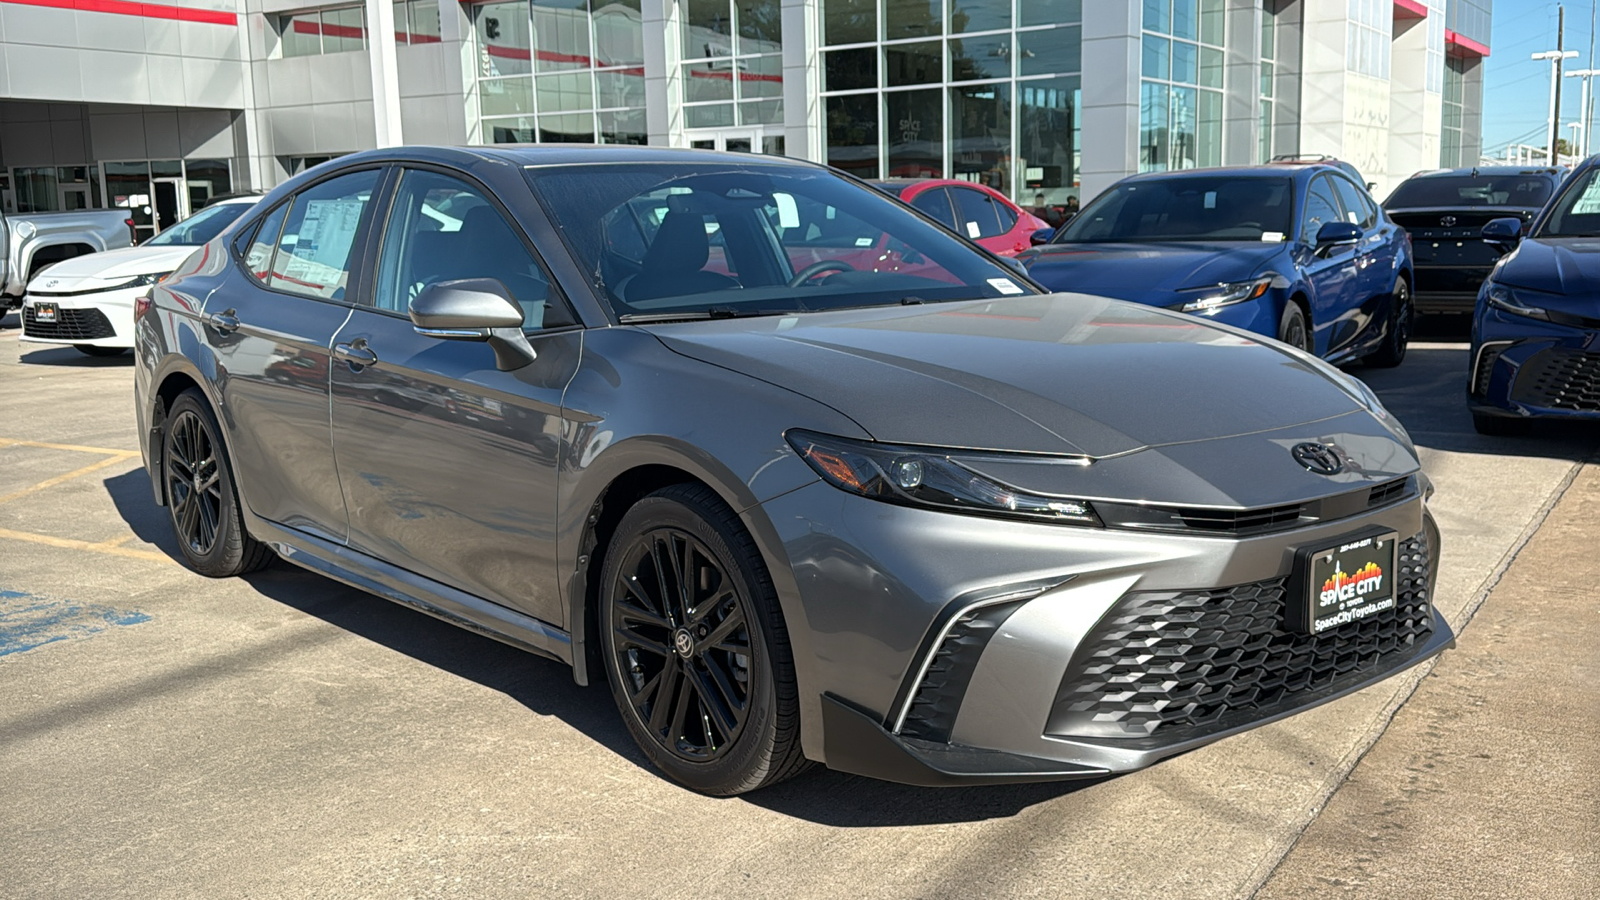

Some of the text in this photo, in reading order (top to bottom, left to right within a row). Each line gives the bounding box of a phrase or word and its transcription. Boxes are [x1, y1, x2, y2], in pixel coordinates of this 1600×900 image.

[899, 118, 920, 131] SPACE
[902, 131, 918, 142] CITY
[1320, 575, 1382, 607] SPACE CITY
[1315, 598, 1392, 631] SpaceCityToyota.com
